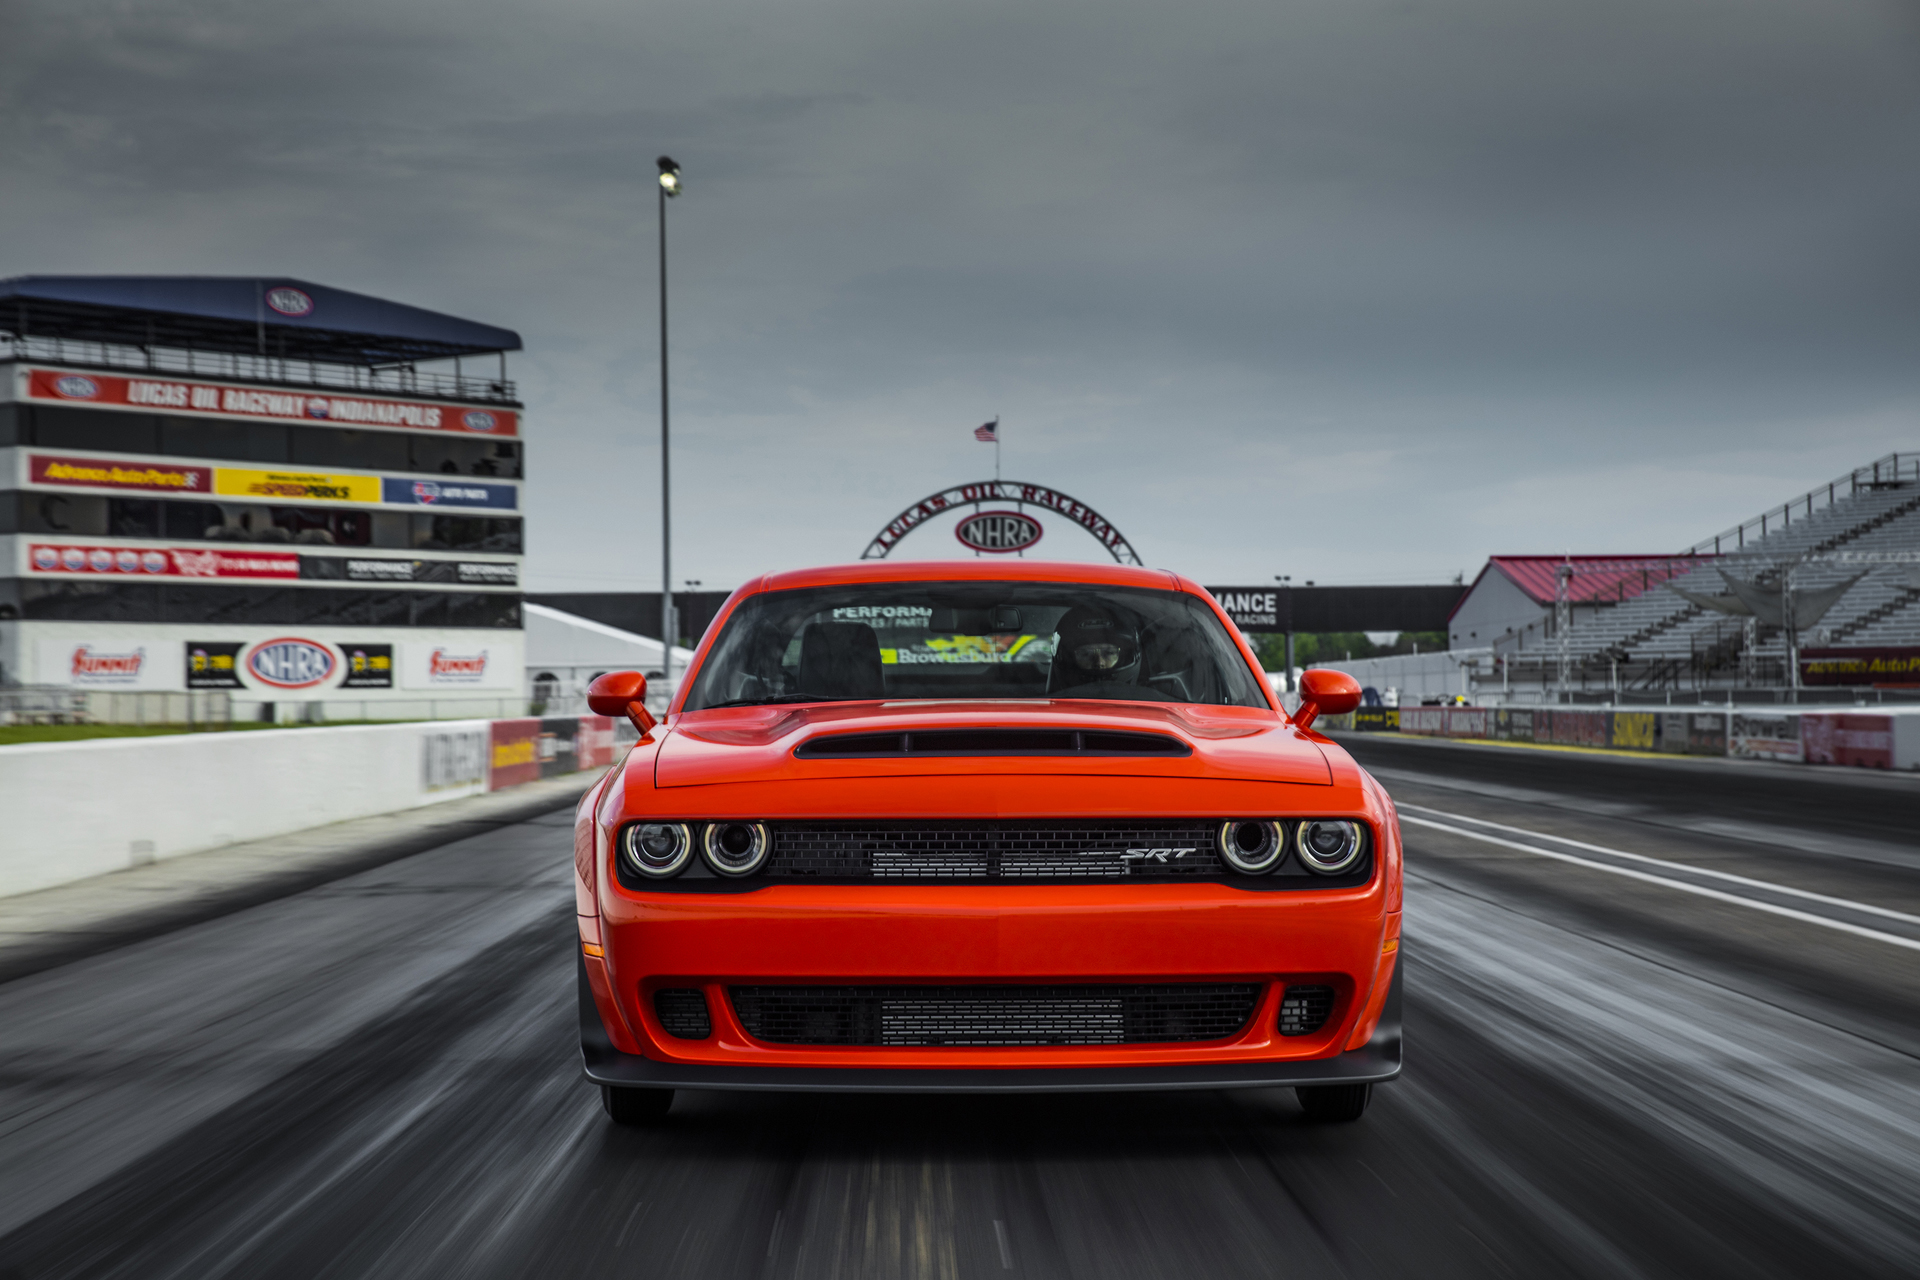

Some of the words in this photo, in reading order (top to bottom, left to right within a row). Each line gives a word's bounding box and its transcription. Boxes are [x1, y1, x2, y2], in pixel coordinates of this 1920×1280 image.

[128, 380, 188, 407] LUCAS
[191, 386, 219, 409] OIL
[223, 389, 304, 417] RACEWAY
[329, 398, 441, 428] INDIANAPOLIS
[877, 492, 948, 550] LUCAS
[960, 484, 1000, 501] OIL
[1021, 484, 1126, 549] RACEWAY
[967, 517, 1033, 549] NHRA
[1235, 614, 1276, 625] RACING
[255, 645, 331, 682] NHRA
[1868, 657, 1907, 674] Auto
[1120, 848, 1196, 862] SRT
